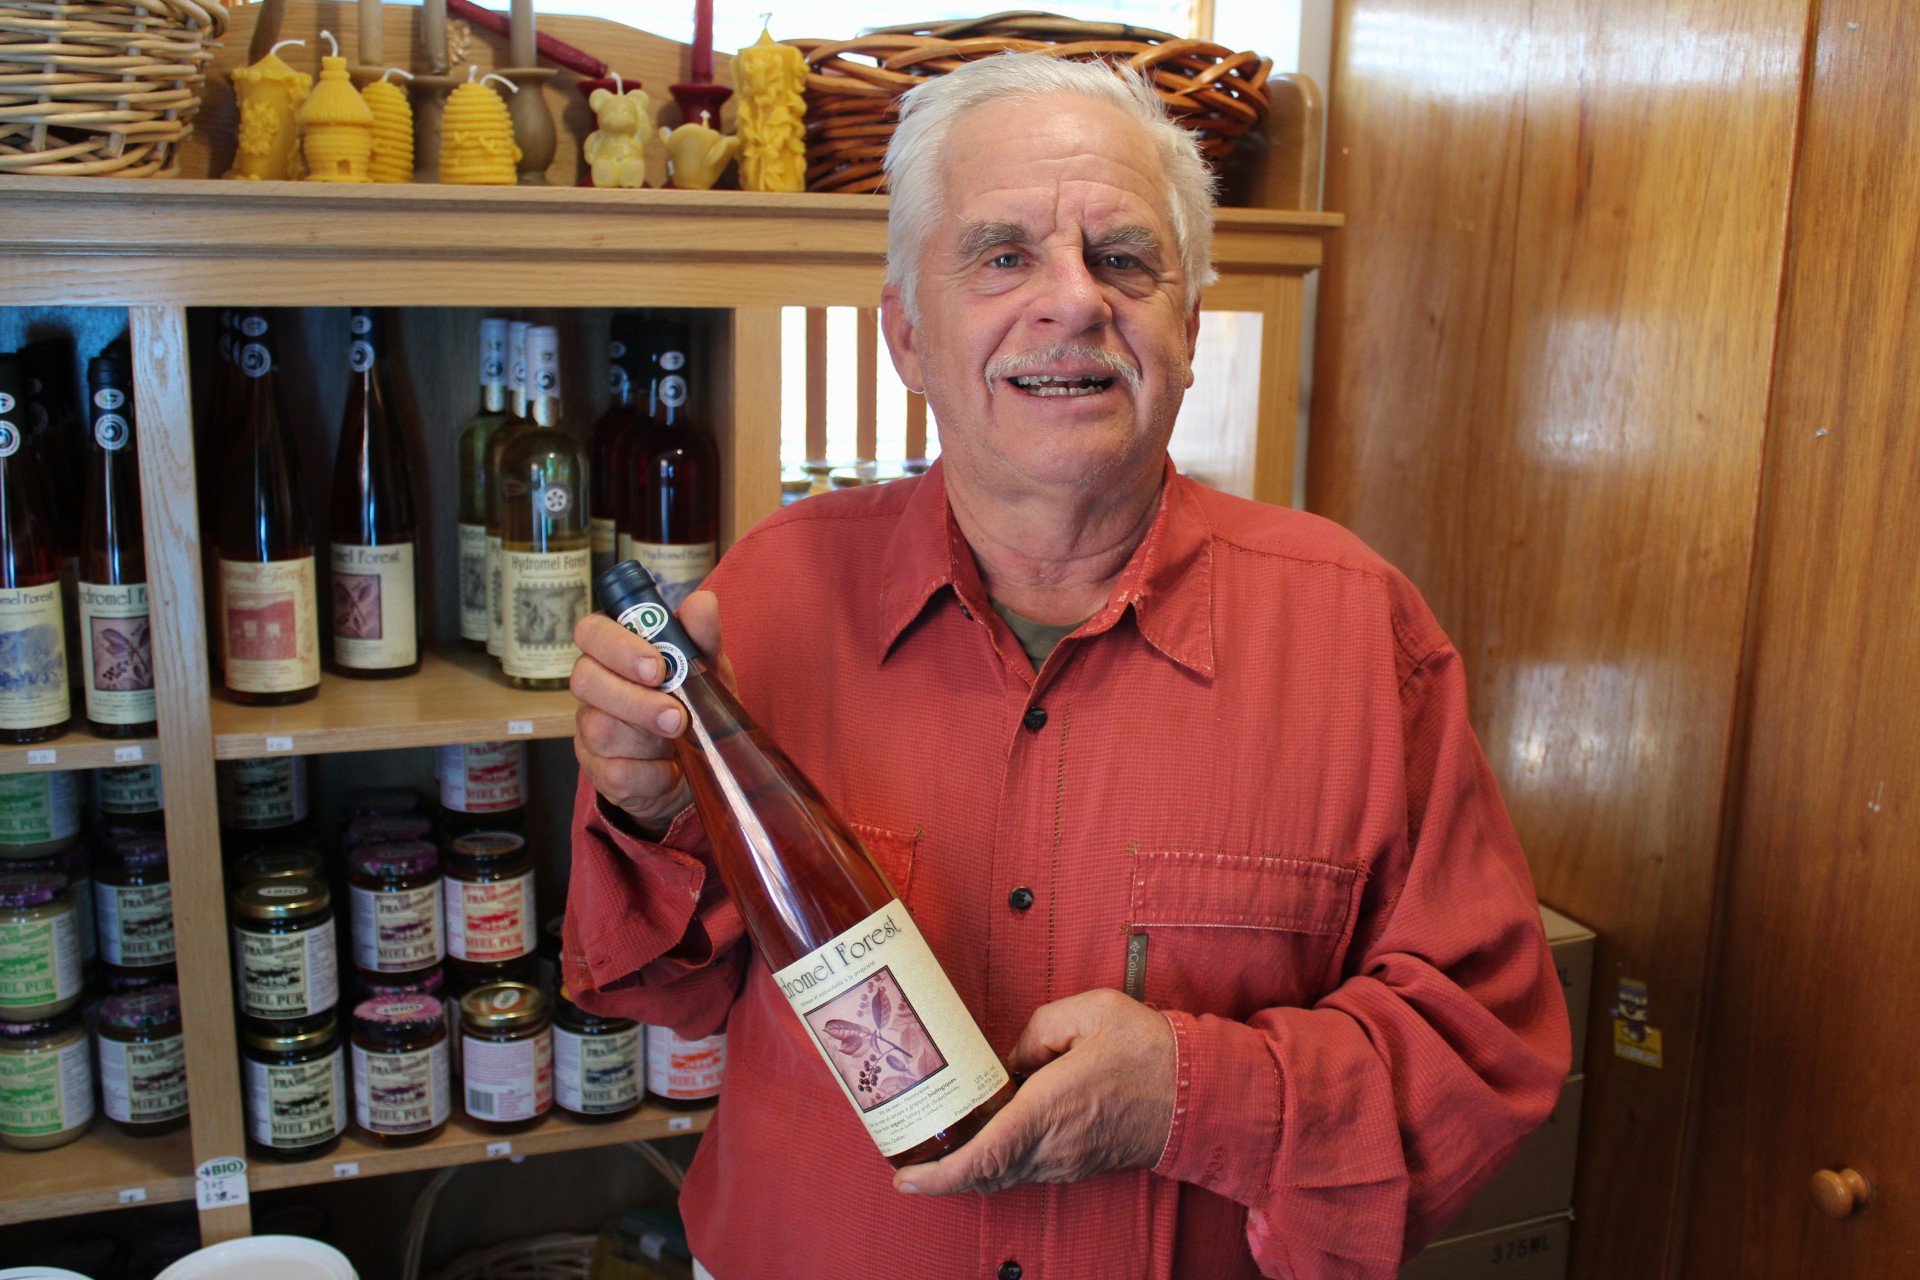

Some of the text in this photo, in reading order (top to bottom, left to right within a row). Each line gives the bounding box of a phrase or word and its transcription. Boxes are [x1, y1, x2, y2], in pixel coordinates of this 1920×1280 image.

[512, 555, 560, 573] Hydromel
[779, 914, 901, 998] dromel Forest
[1492, 1233, 1550, 1264] 375ML
